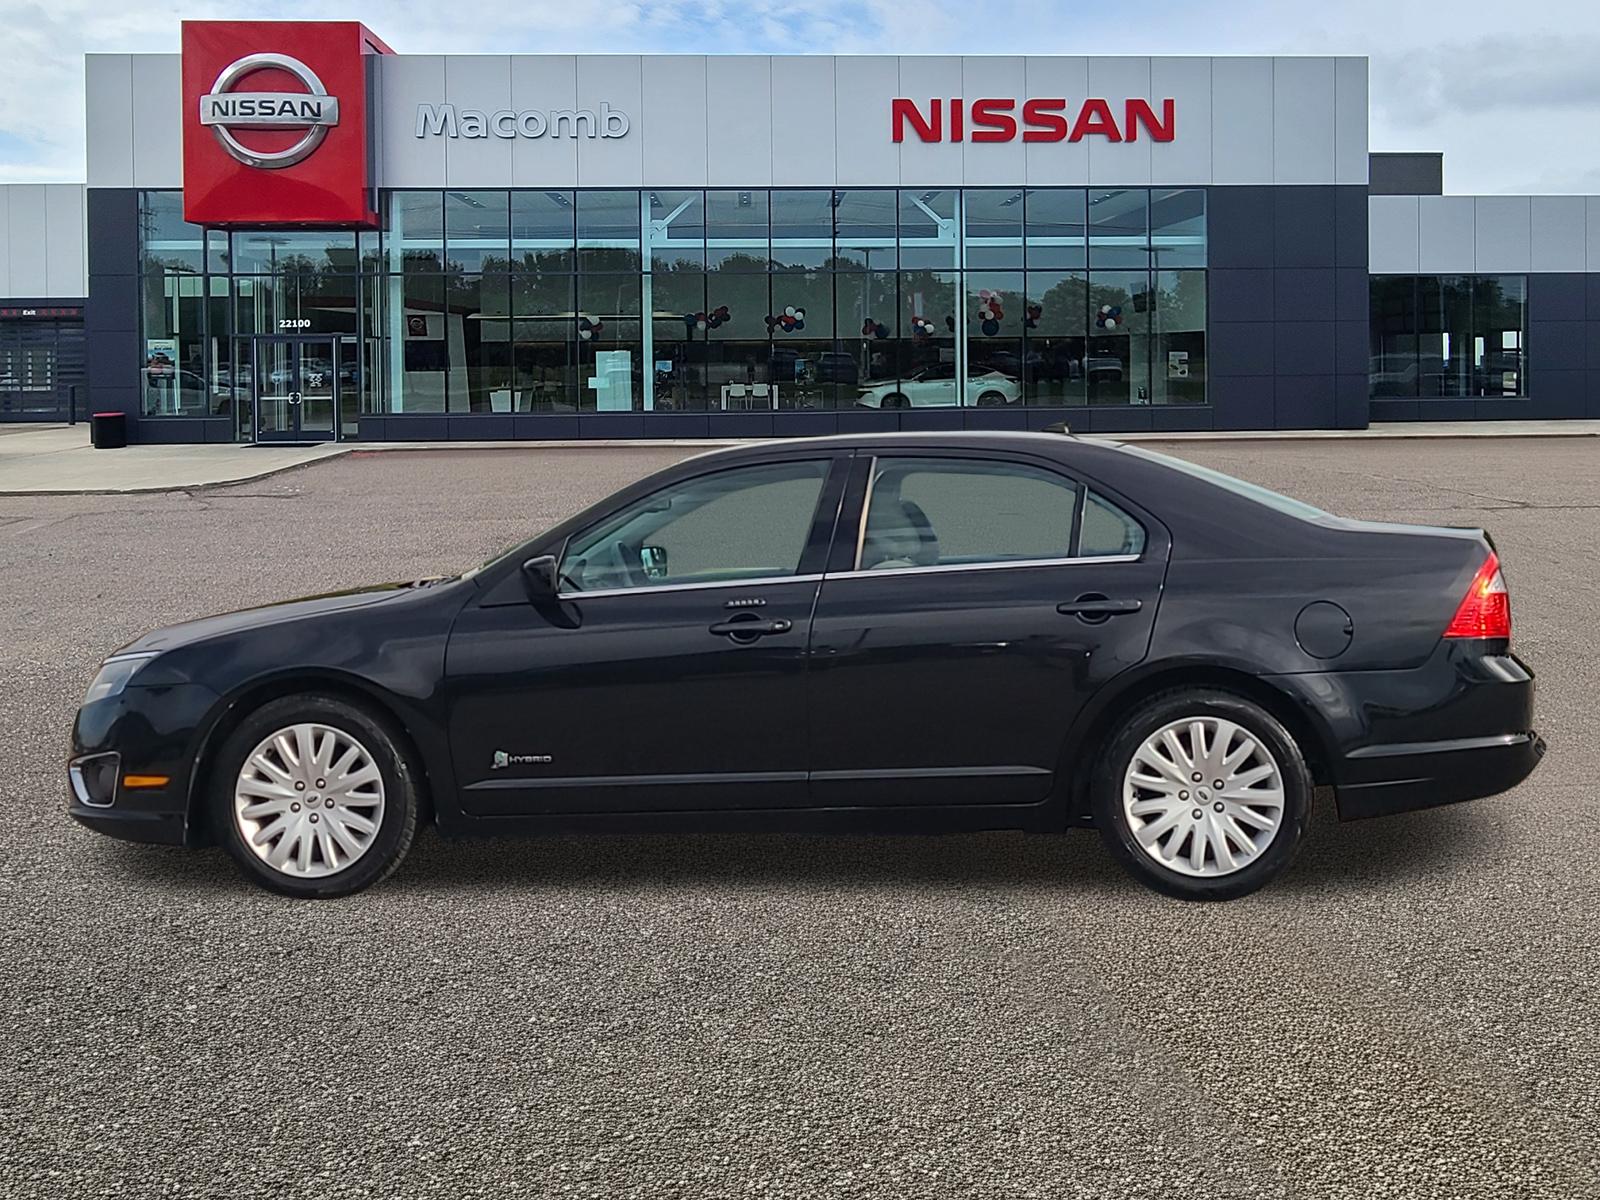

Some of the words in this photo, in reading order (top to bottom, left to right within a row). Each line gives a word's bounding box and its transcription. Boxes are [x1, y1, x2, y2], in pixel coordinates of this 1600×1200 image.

[211, 100, 322, 117] NISSAN
[415, 101, 630, 138] Macomb
[892, 98, 1175, 142] NISSAN
[279, 319, 311, 328] 22100
[508, 755, 552, 764] HYBRID
